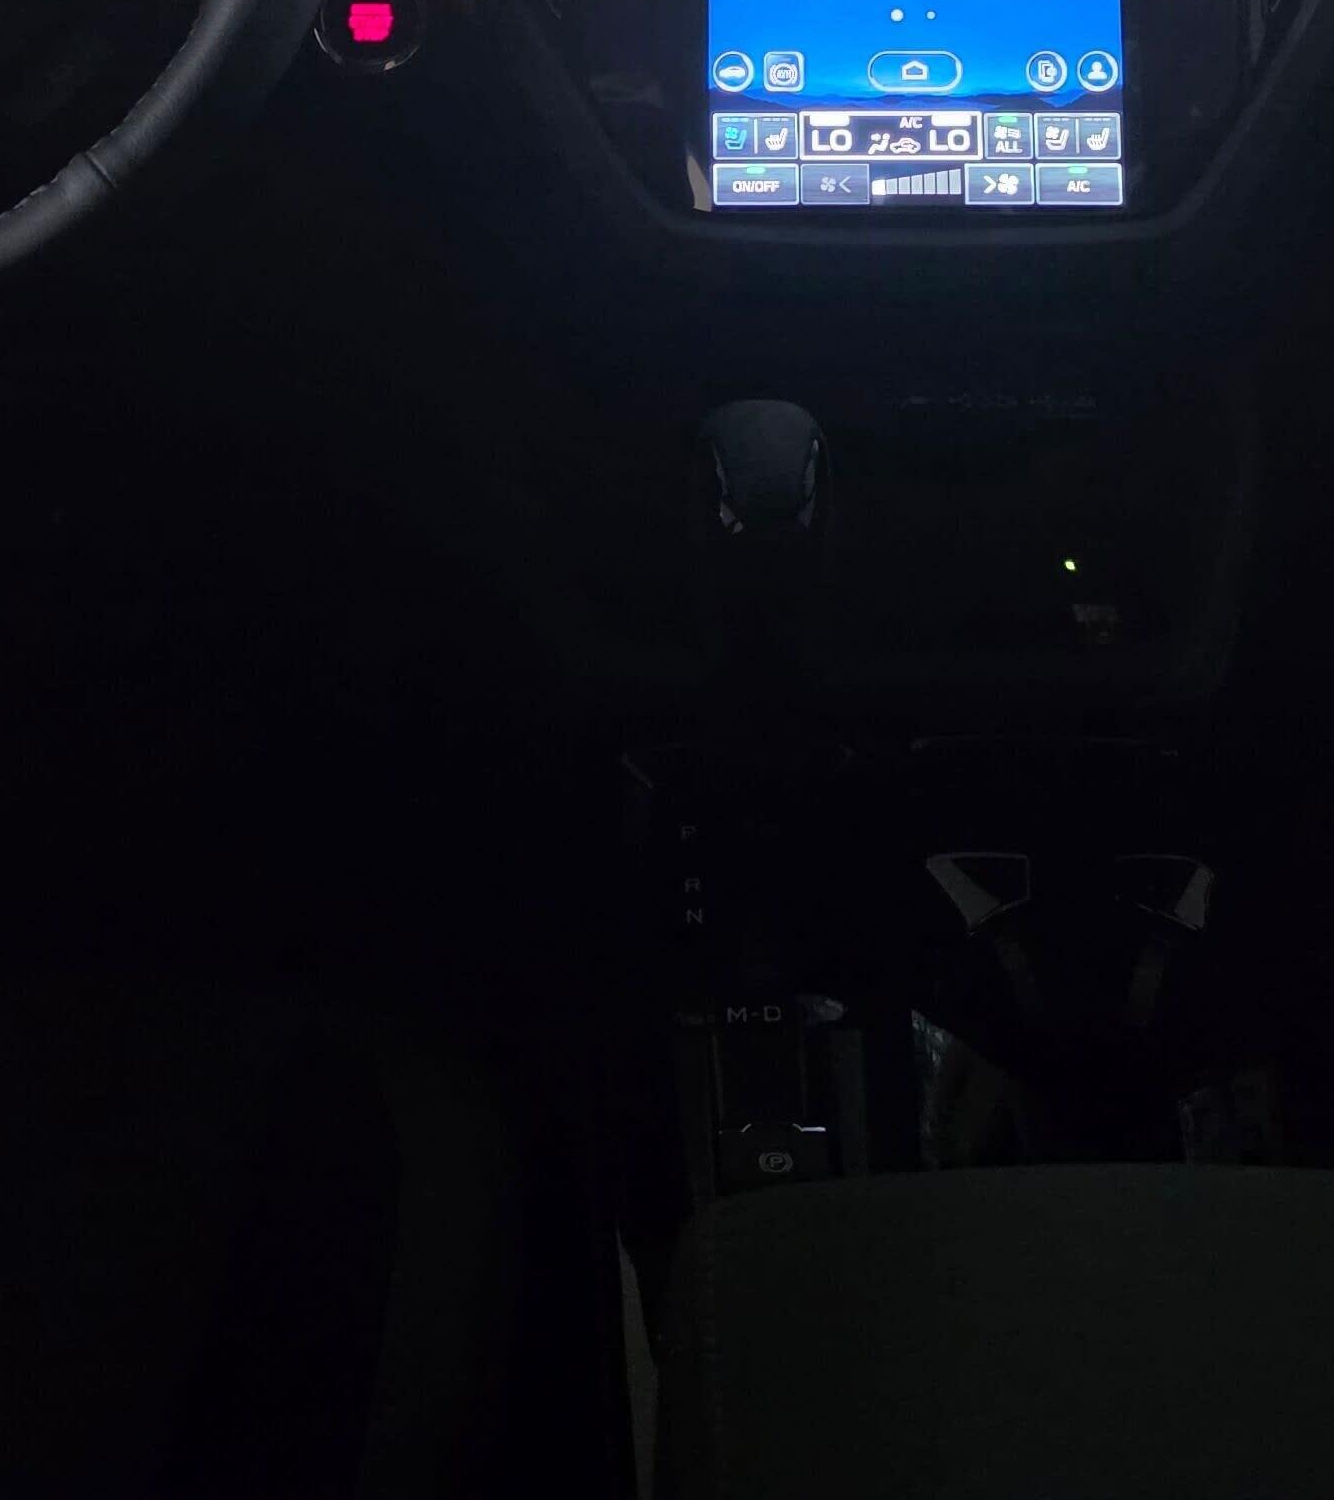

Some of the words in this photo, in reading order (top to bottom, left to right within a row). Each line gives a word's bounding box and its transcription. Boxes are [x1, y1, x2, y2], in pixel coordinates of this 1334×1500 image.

[899, 117, 922, 129] A/C
[811, 129, 852, 152] LO
[929, 129, 971, 152] LO
[995, 140, 1023, 154] ALL
[732, 180, 780, 193] ON/OFF
[1067, 180, 1091, 193] A/C
[684, 877, 702, 892] R
[685, 908, 704, 924] N
